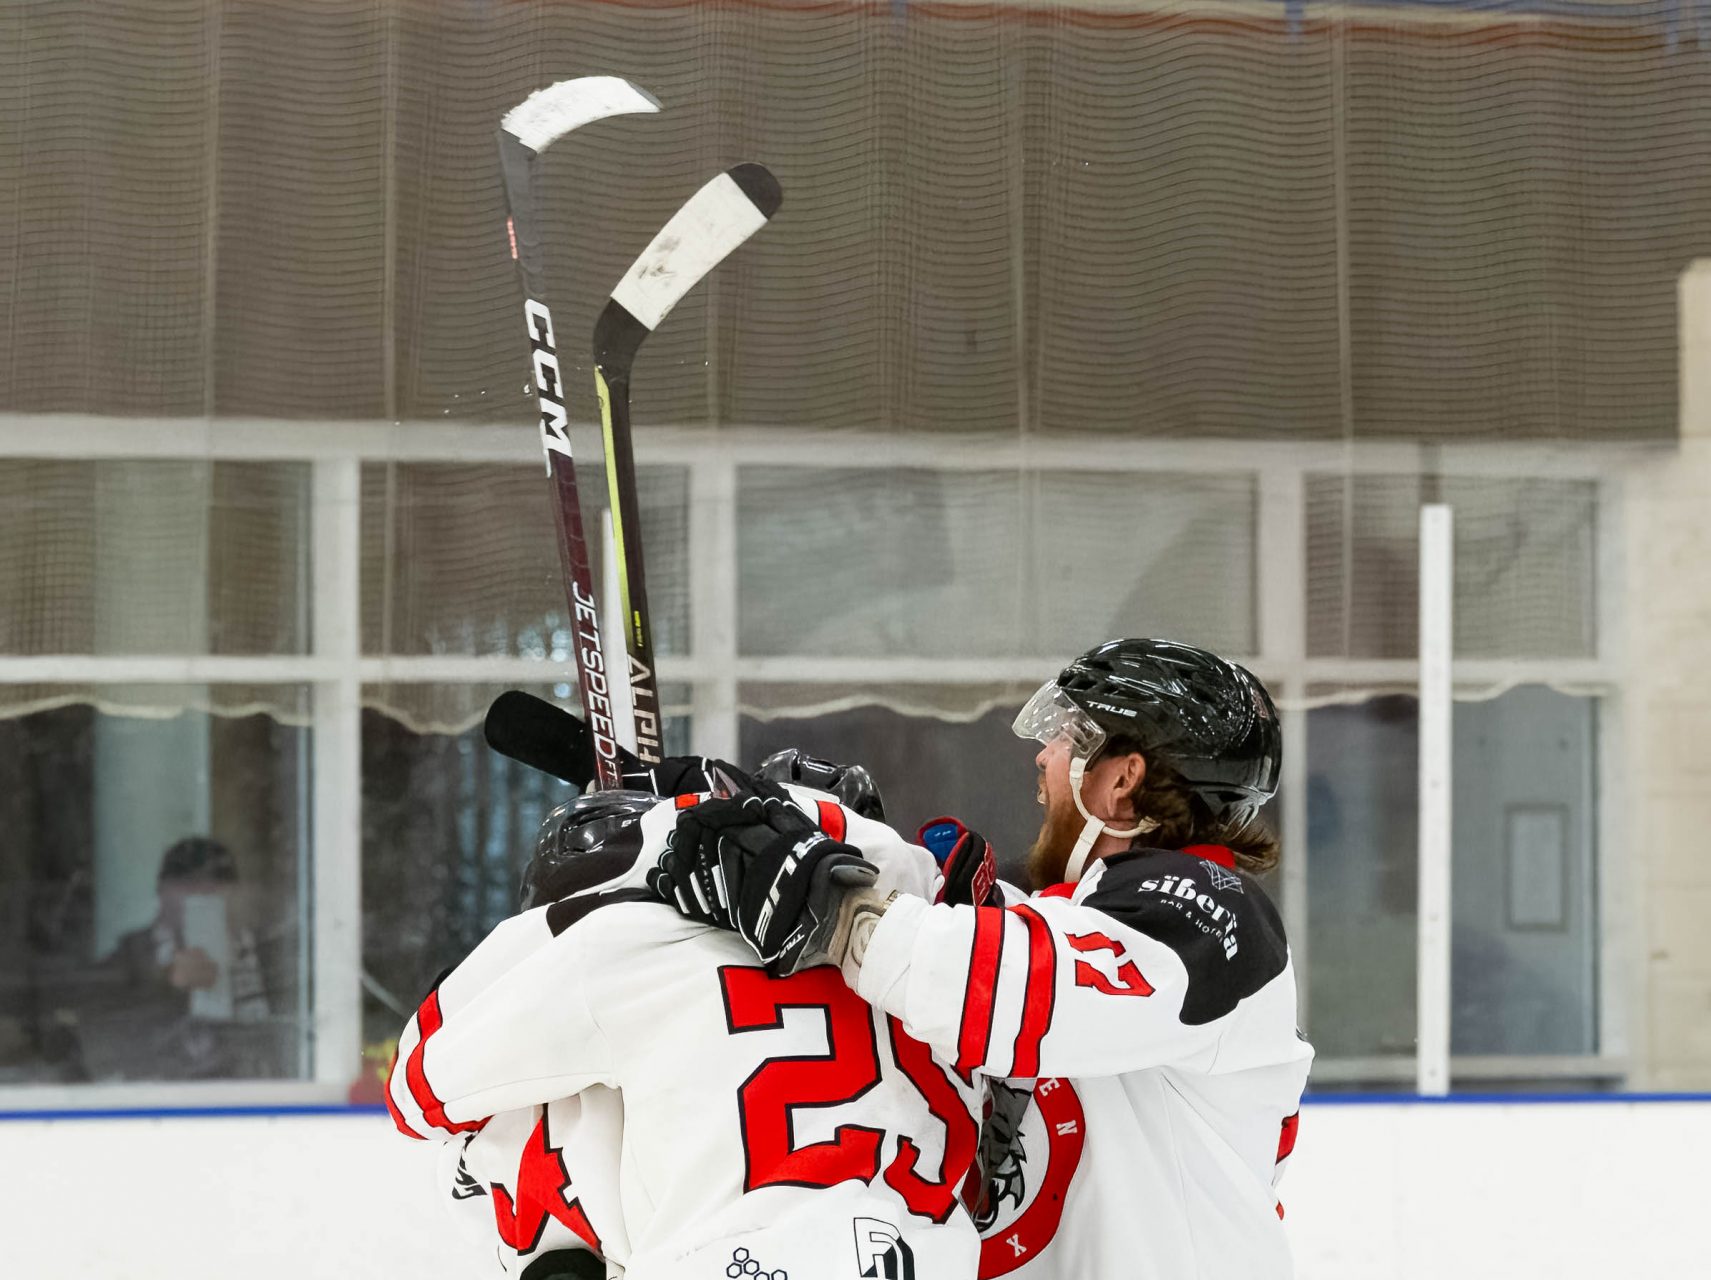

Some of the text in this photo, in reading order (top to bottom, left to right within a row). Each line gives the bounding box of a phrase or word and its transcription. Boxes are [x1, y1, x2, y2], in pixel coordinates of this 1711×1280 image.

[525, 299, 572, 478] CCM
[573, 581, 617, 759] JETSPEED
[627, 653, 661, 765] ALPH
[1086, 700, 1137, 717] TRUE
[754, 831, 827, 947] RUE
